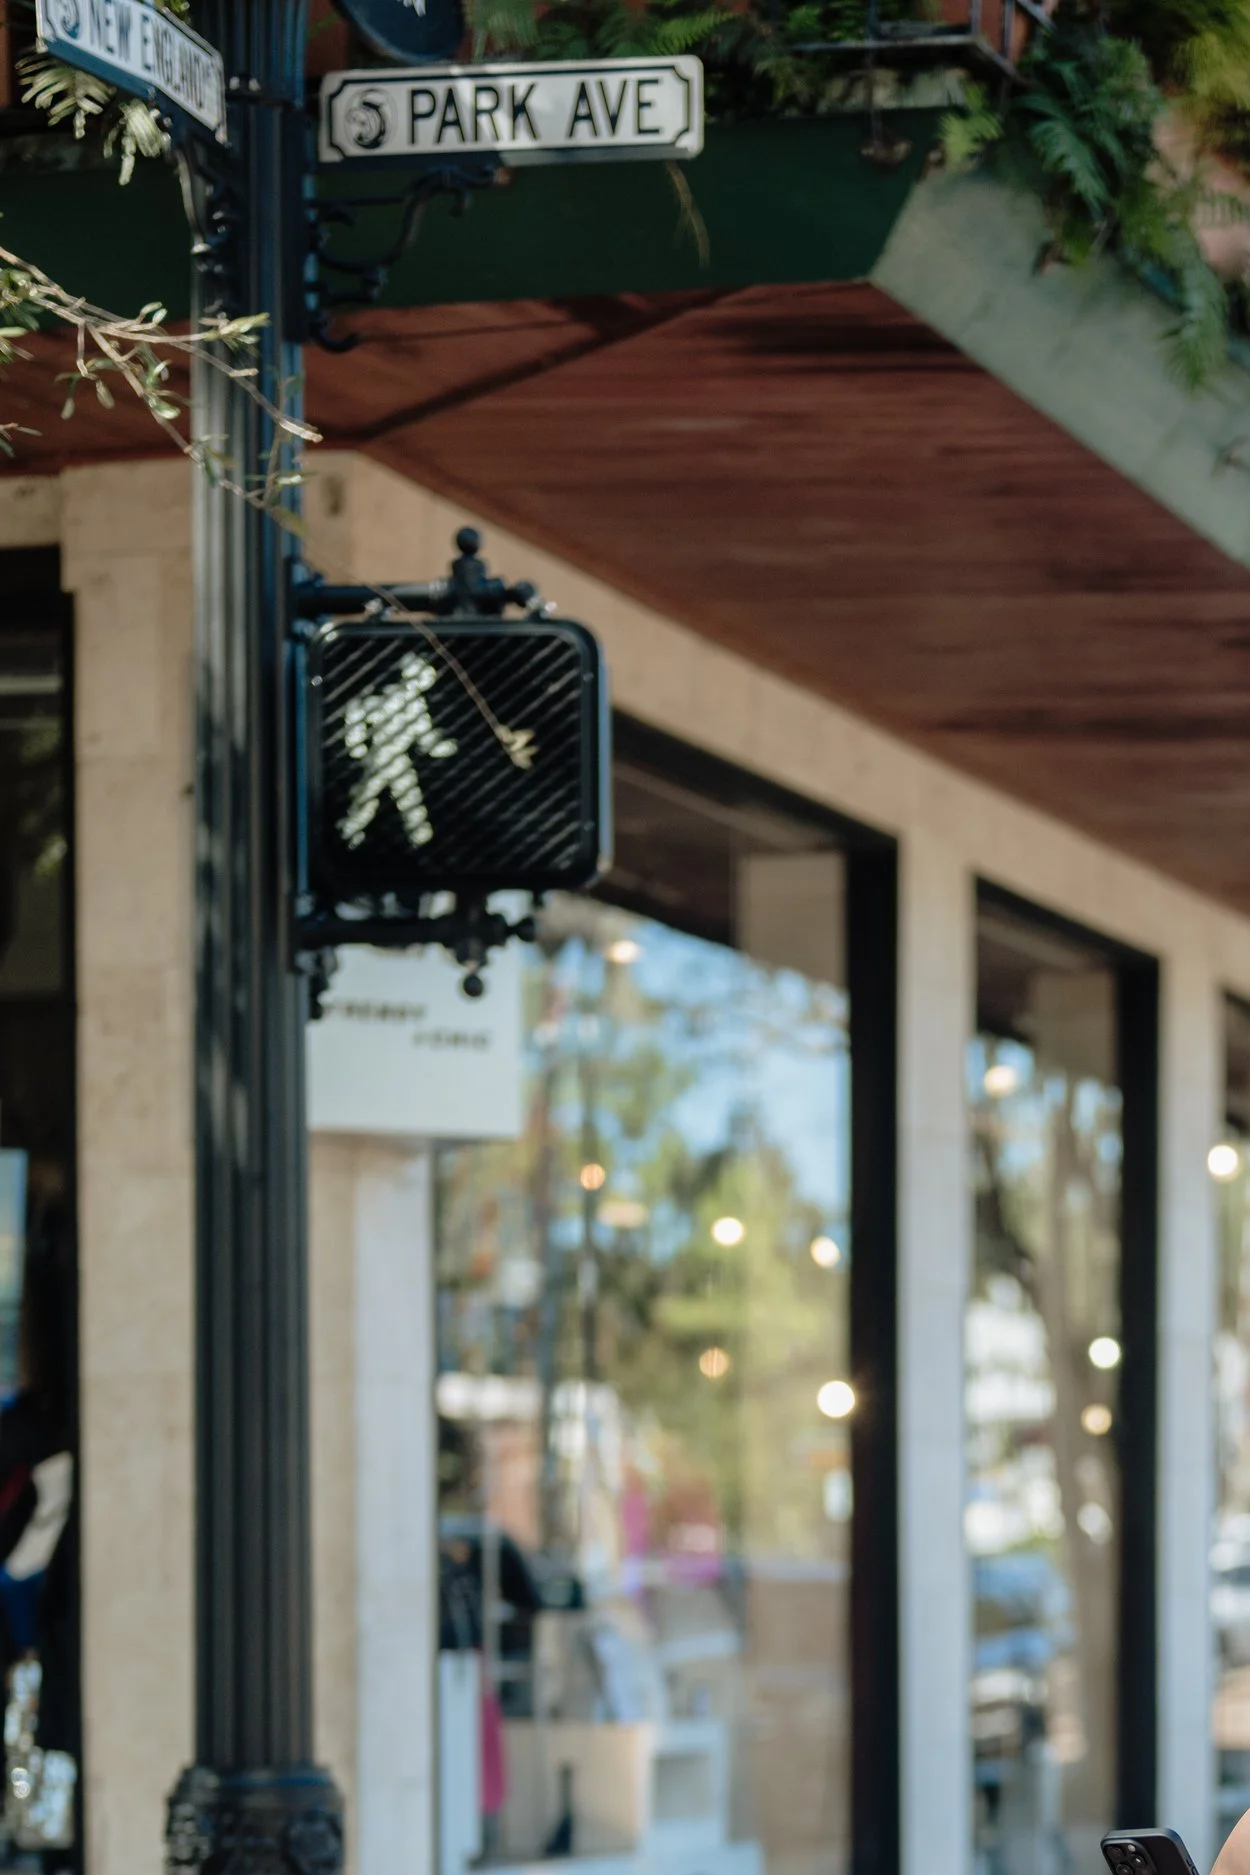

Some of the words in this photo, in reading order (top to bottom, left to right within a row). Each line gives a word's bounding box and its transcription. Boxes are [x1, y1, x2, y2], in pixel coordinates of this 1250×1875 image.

[89, 0, 131, 62] NEW
[142, 13, 204, 110] ENGLAND
[407, 83, 538, 145] PARK
[568, 79, 660, 139] AVE
